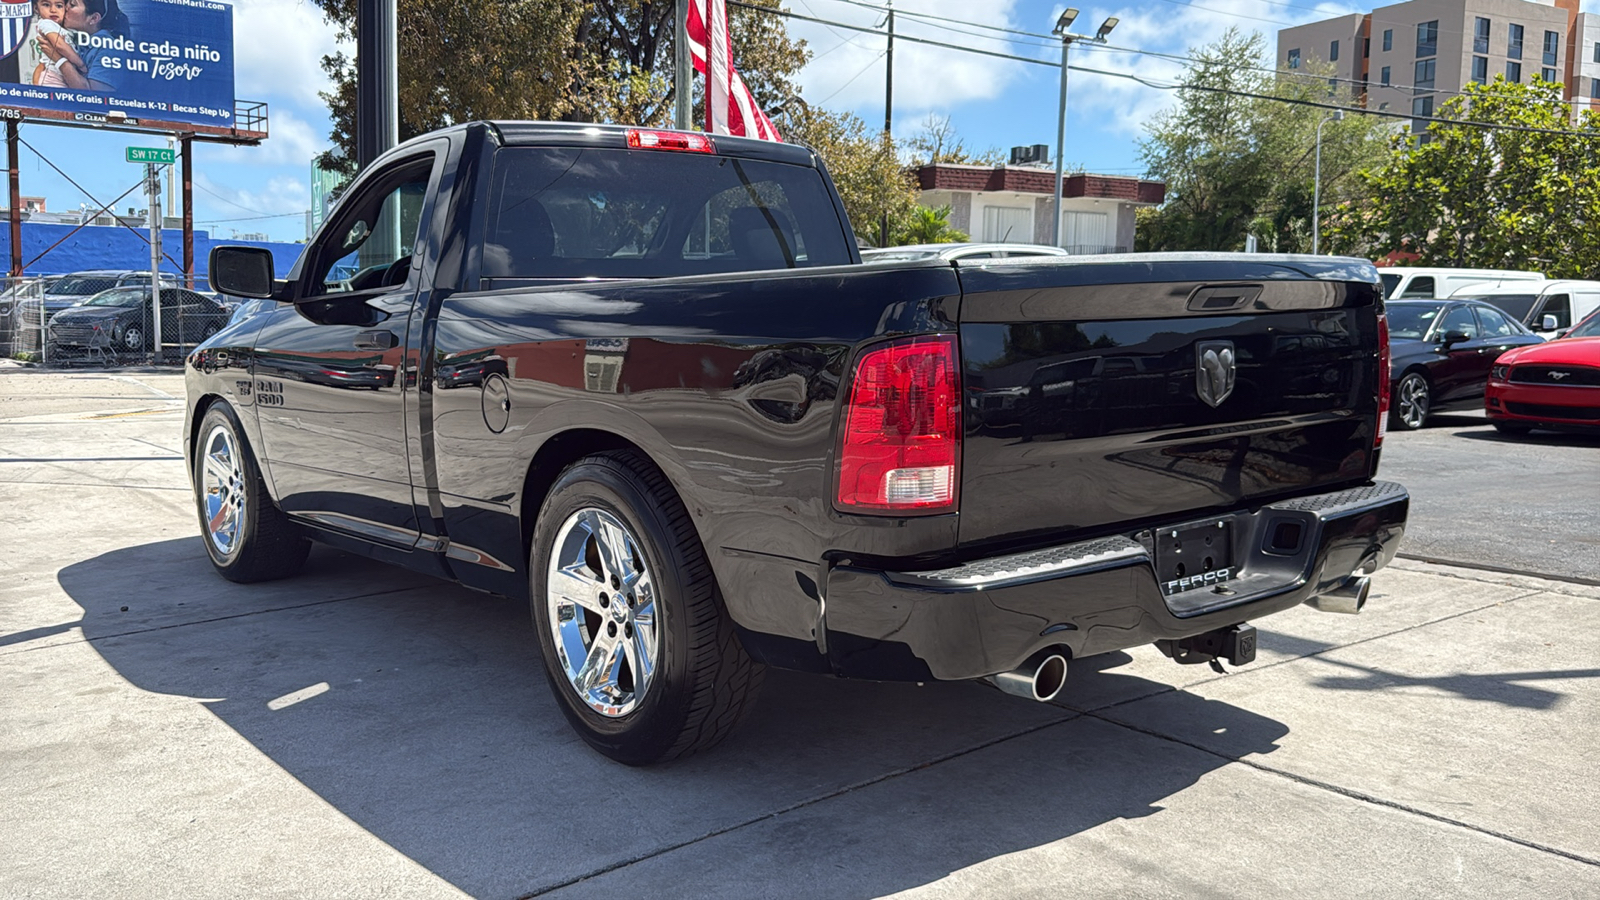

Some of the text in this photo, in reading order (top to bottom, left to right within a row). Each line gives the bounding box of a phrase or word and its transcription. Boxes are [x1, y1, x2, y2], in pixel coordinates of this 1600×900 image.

[77, 31, 221, 63] Donde cada niño
[101, 56, 203, 81] es un Tesoro
[9, 87, 22, 97] de
[23, 89, 49, 100] niños
[55, 92, 75, 102] VPK
[76, 94, 103, 104] Gratis
[109, 97, 147, 109] Escuelas
[148, 102, 167, 111] K-12
[173, 104, 198, 114] Becas
[199, 106, 218, 118] Step
[219, 109, 231, 119] Up
[131, 149, 172, 161] SW 17 Ct
[256, 381, 284, 393] RAM
[256, 393, 285, 406] 1500
[1167, 568, 1229, 589] FERCO
